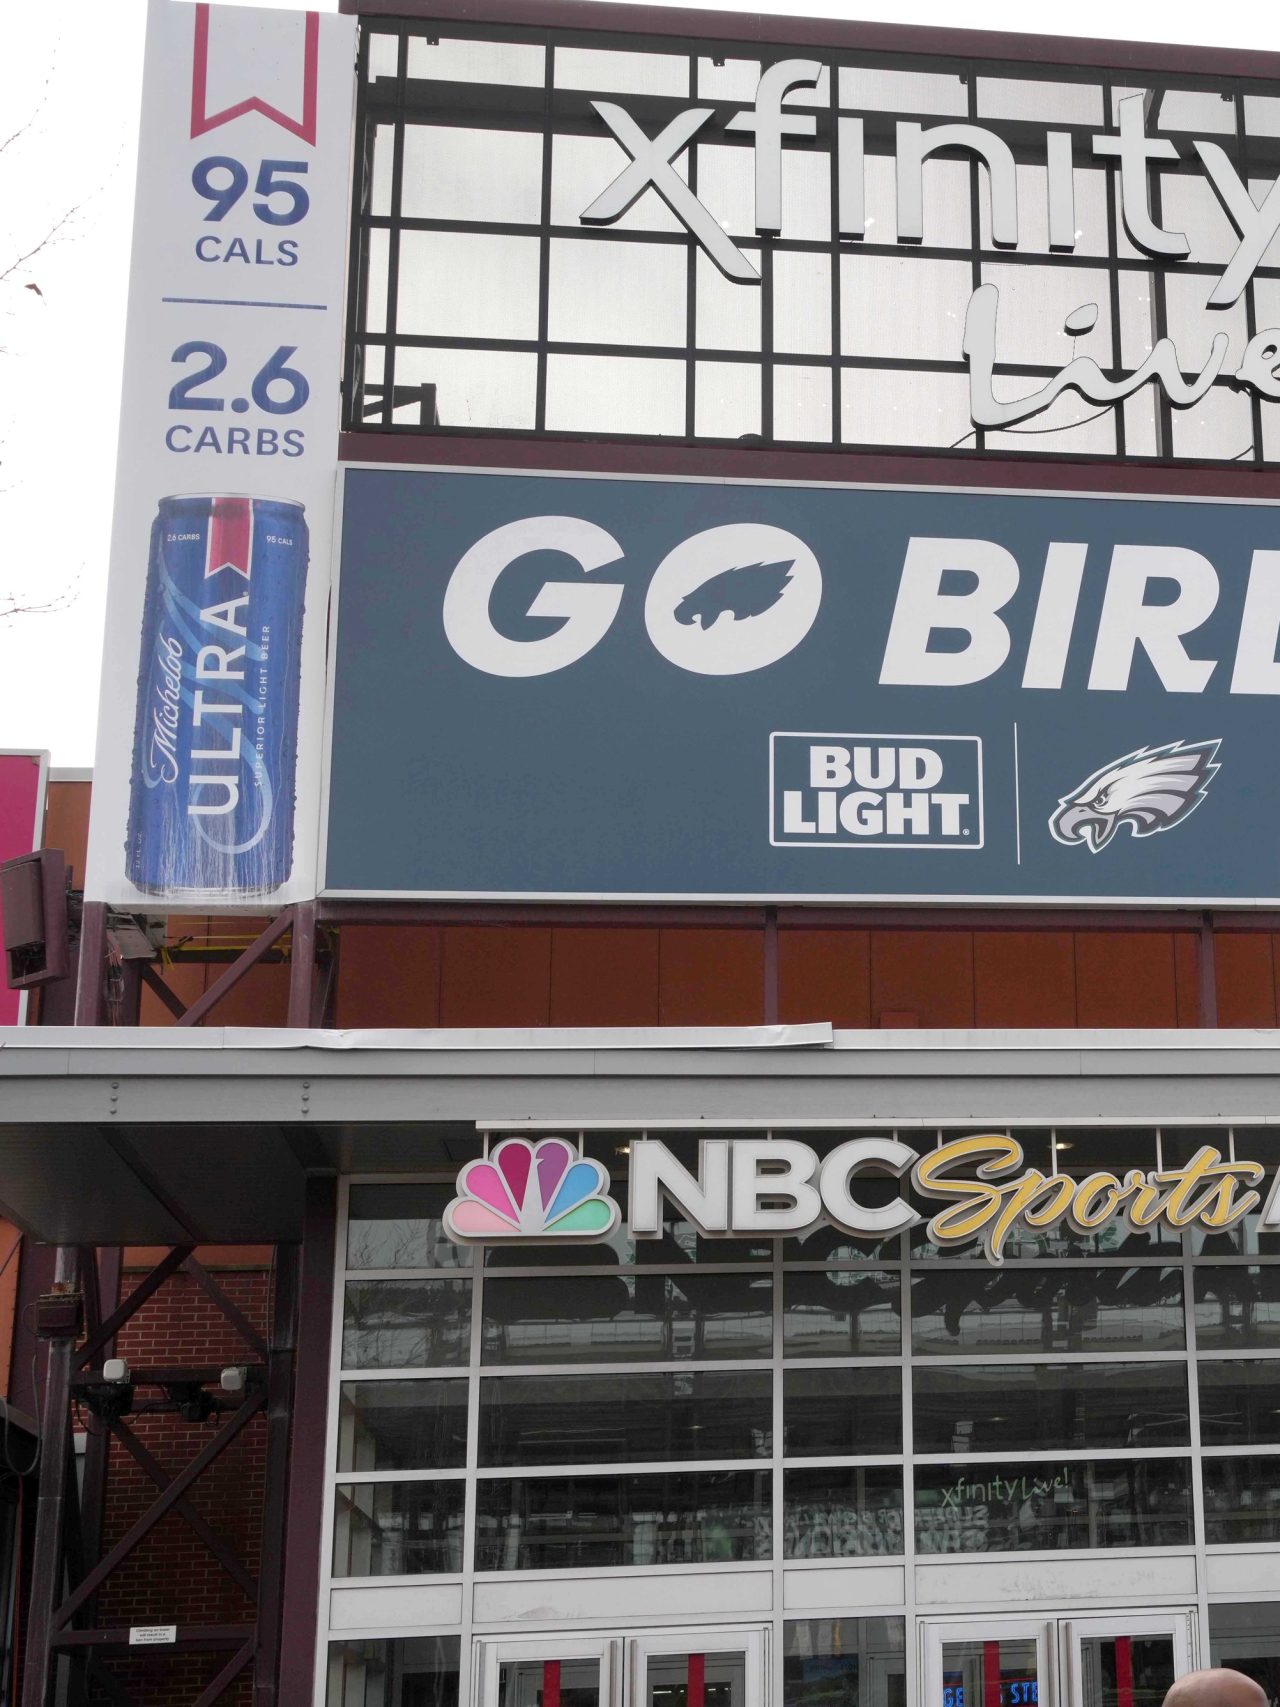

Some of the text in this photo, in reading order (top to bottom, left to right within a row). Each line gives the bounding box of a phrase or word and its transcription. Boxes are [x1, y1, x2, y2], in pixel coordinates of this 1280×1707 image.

[191, 156, 310, 227] 95
[195, 236, 299, 267] CALS
[167, 340, 310, 415] 2.6
[165, 424, 305, 458] CARBS
[266, 535, 293, 546] 95 CALS
[442, 514, 823, 678] GO
[150, 633, 183, 784] Michelob
[187, 595, 250, 815] ULTRA
[253, 625, 271, 788] SUPERIOR LIGHT BEER
[809, 745, 944, 789] BUD
[783, 790, 970, 836] LIGHT
[629, 1137, 921, 1238] NBC
[915, 1132, 1265, 1266] Sports
[941, 1467, 1070, 1512] xfinity Live!
